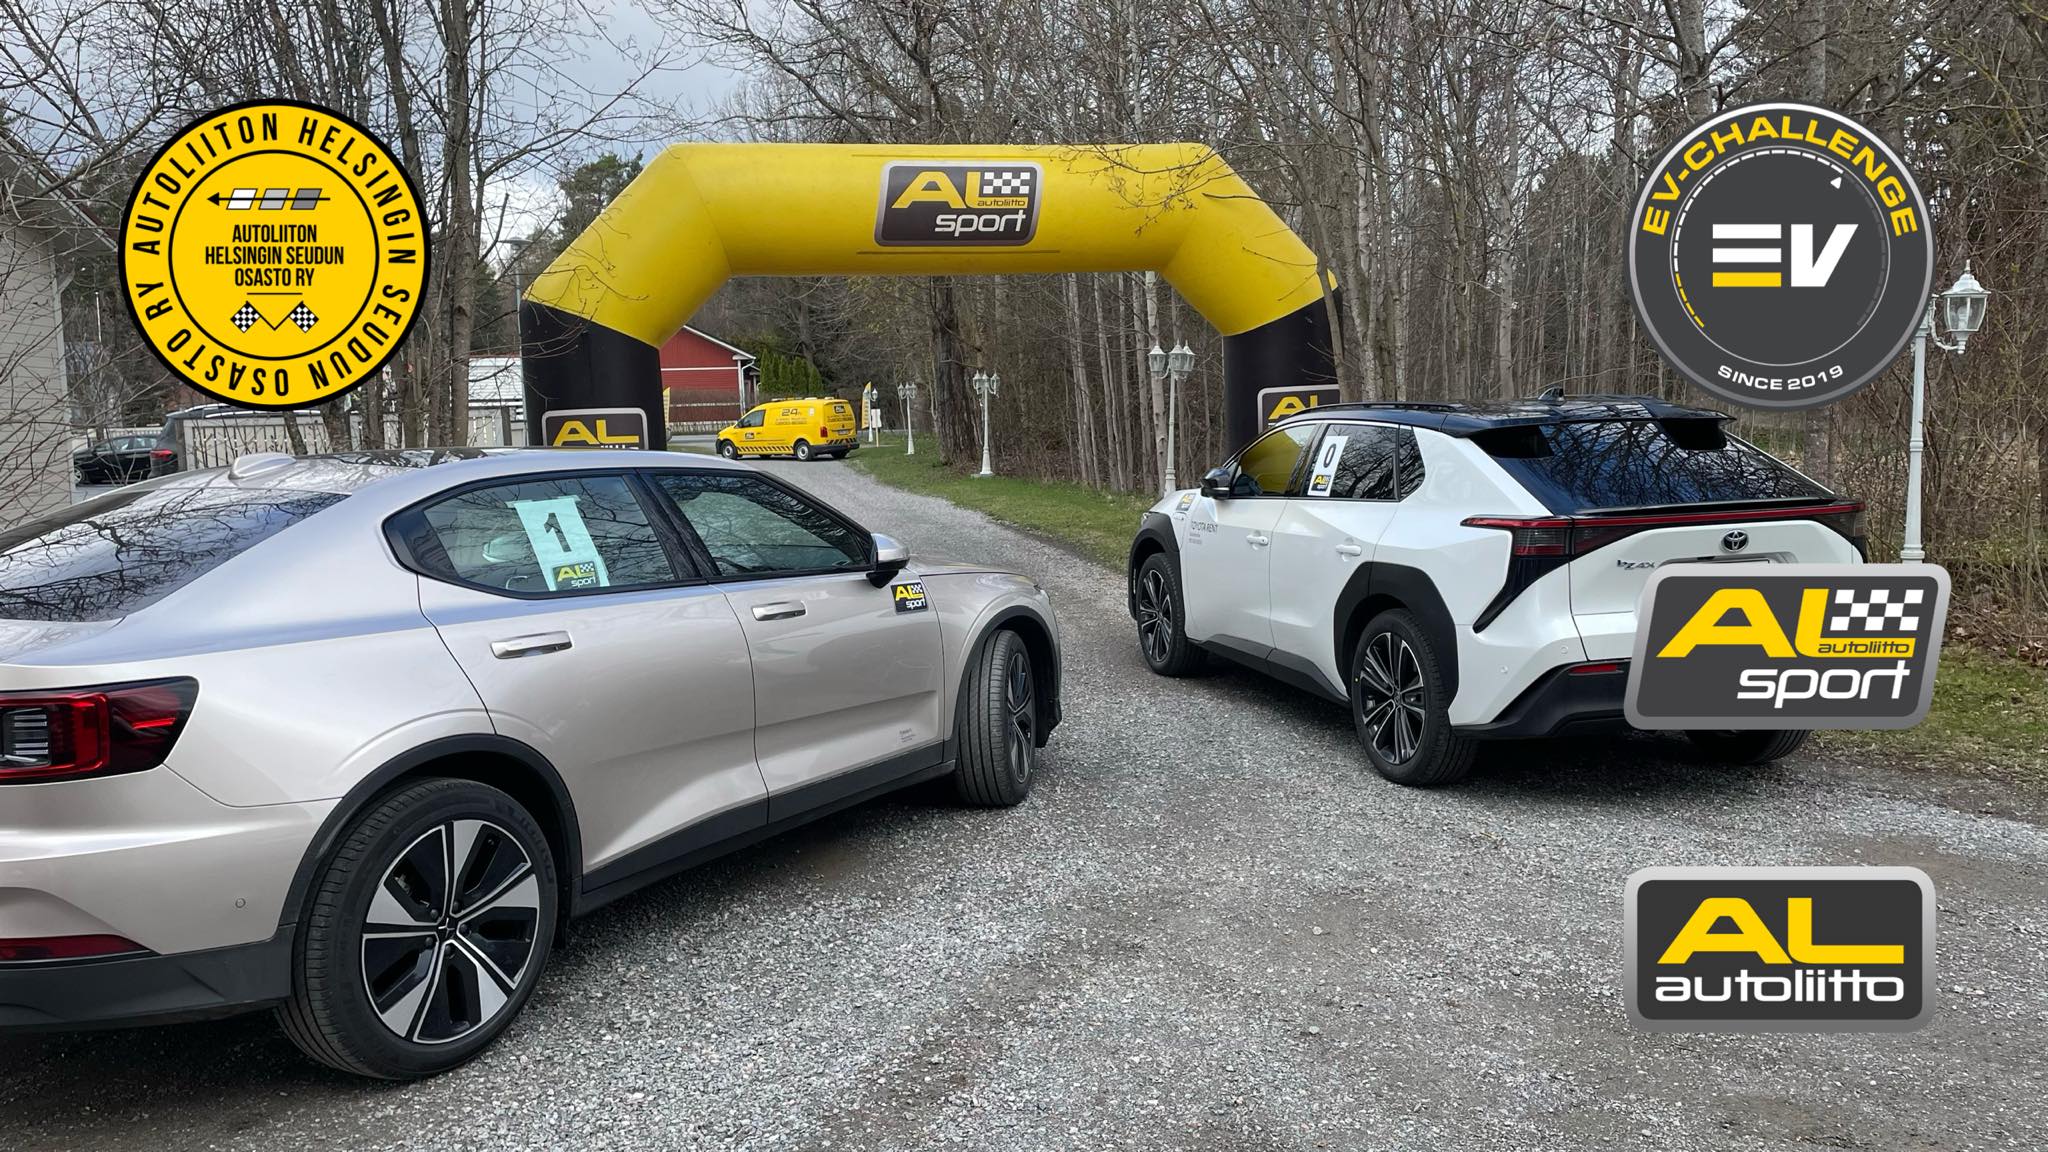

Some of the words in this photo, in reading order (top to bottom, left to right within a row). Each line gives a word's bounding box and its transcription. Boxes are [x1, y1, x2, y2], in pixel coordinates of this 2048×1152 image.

[891, 171, 1029, 209] AL
[977, 199, 1026, 207] autoliitto
[935, 209, 1026, 237] sport
[552, 419, 640, 447] AL
[1323, 443, 1337, 468] 0
[544, 512, 572, 552] 1
[557, 563, 596, 582] AL
[571, 577, 596, 588] sport
[895, 585, 924, 601] AL
[905, 599, 926, 610] sport
